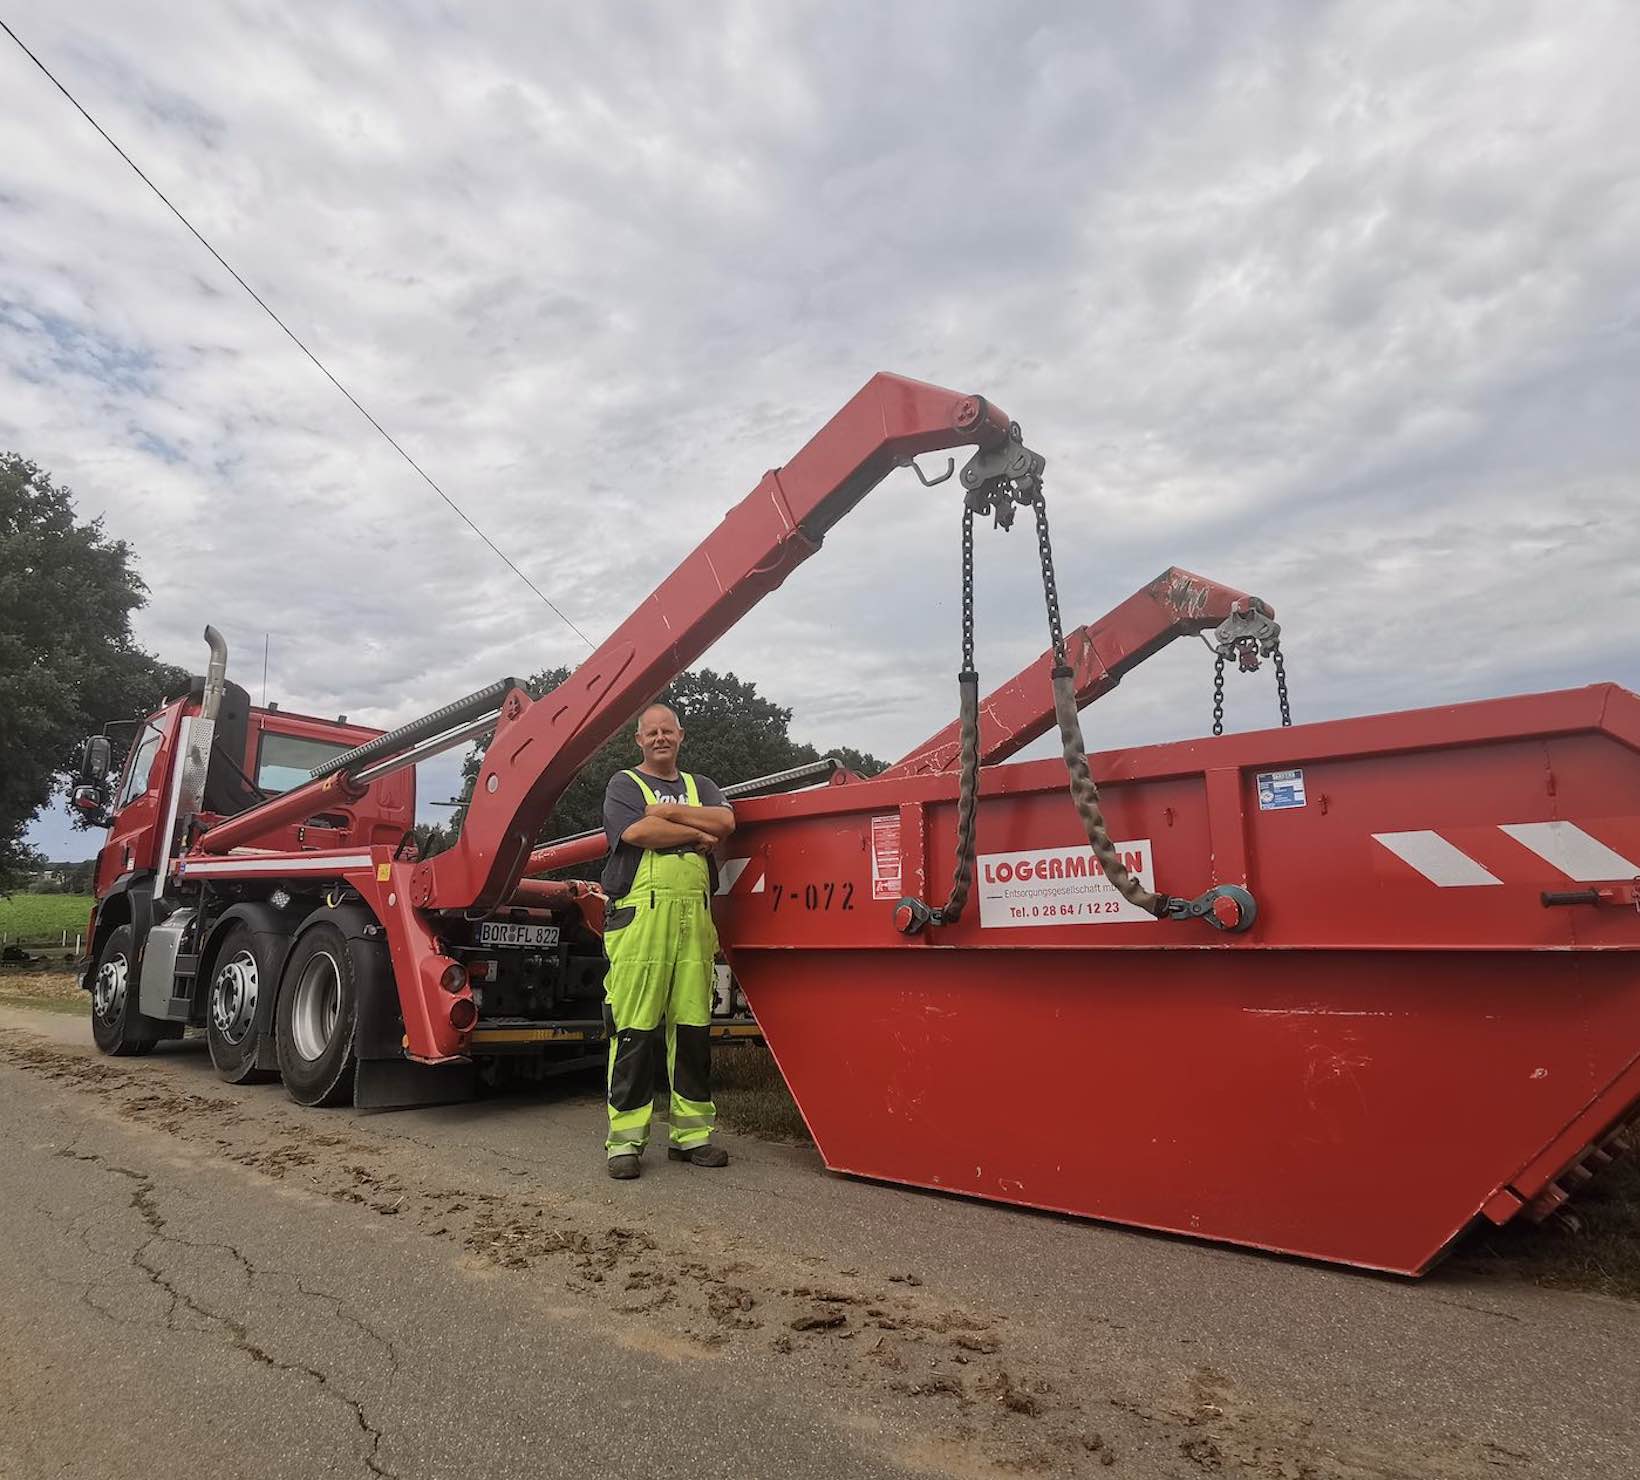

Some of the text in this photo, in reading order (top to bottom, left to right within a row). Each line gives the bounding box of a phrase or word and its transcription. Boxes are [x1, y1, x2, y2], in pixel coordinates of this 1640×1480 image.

[985, 851, 1143, 884] LOGERMAN
[1004, 883, 1101, 898] Entsorgungsgesellschaft
[1010, 902, 1120, 918] Tel. 0 28 64 / 12 23
[482, 925, 558, 944] BOR FL 822
